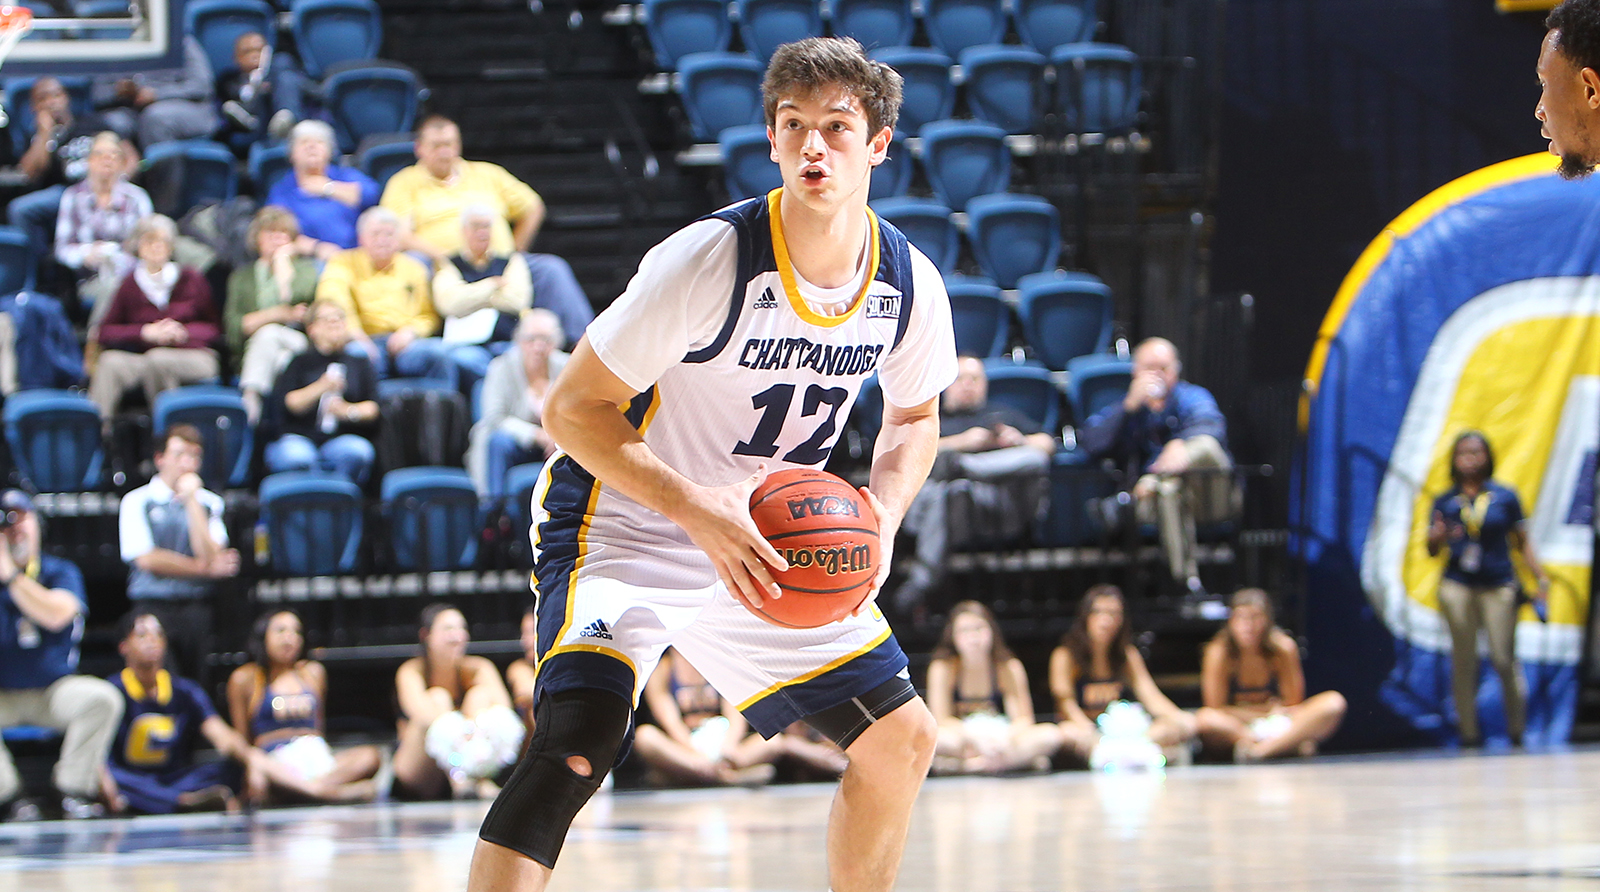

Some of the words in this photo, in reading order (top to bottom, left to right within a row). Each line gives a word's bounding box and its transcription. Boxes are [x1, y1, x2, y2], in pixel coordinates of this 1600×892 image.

[753, 300, 778, 310] adidas
[867, 296, 902, 317] SOCON
[732, 383, 849, 466] 12
[787, 496, 860, 520] NCAA
[580, 630, 613, 640] adidas
